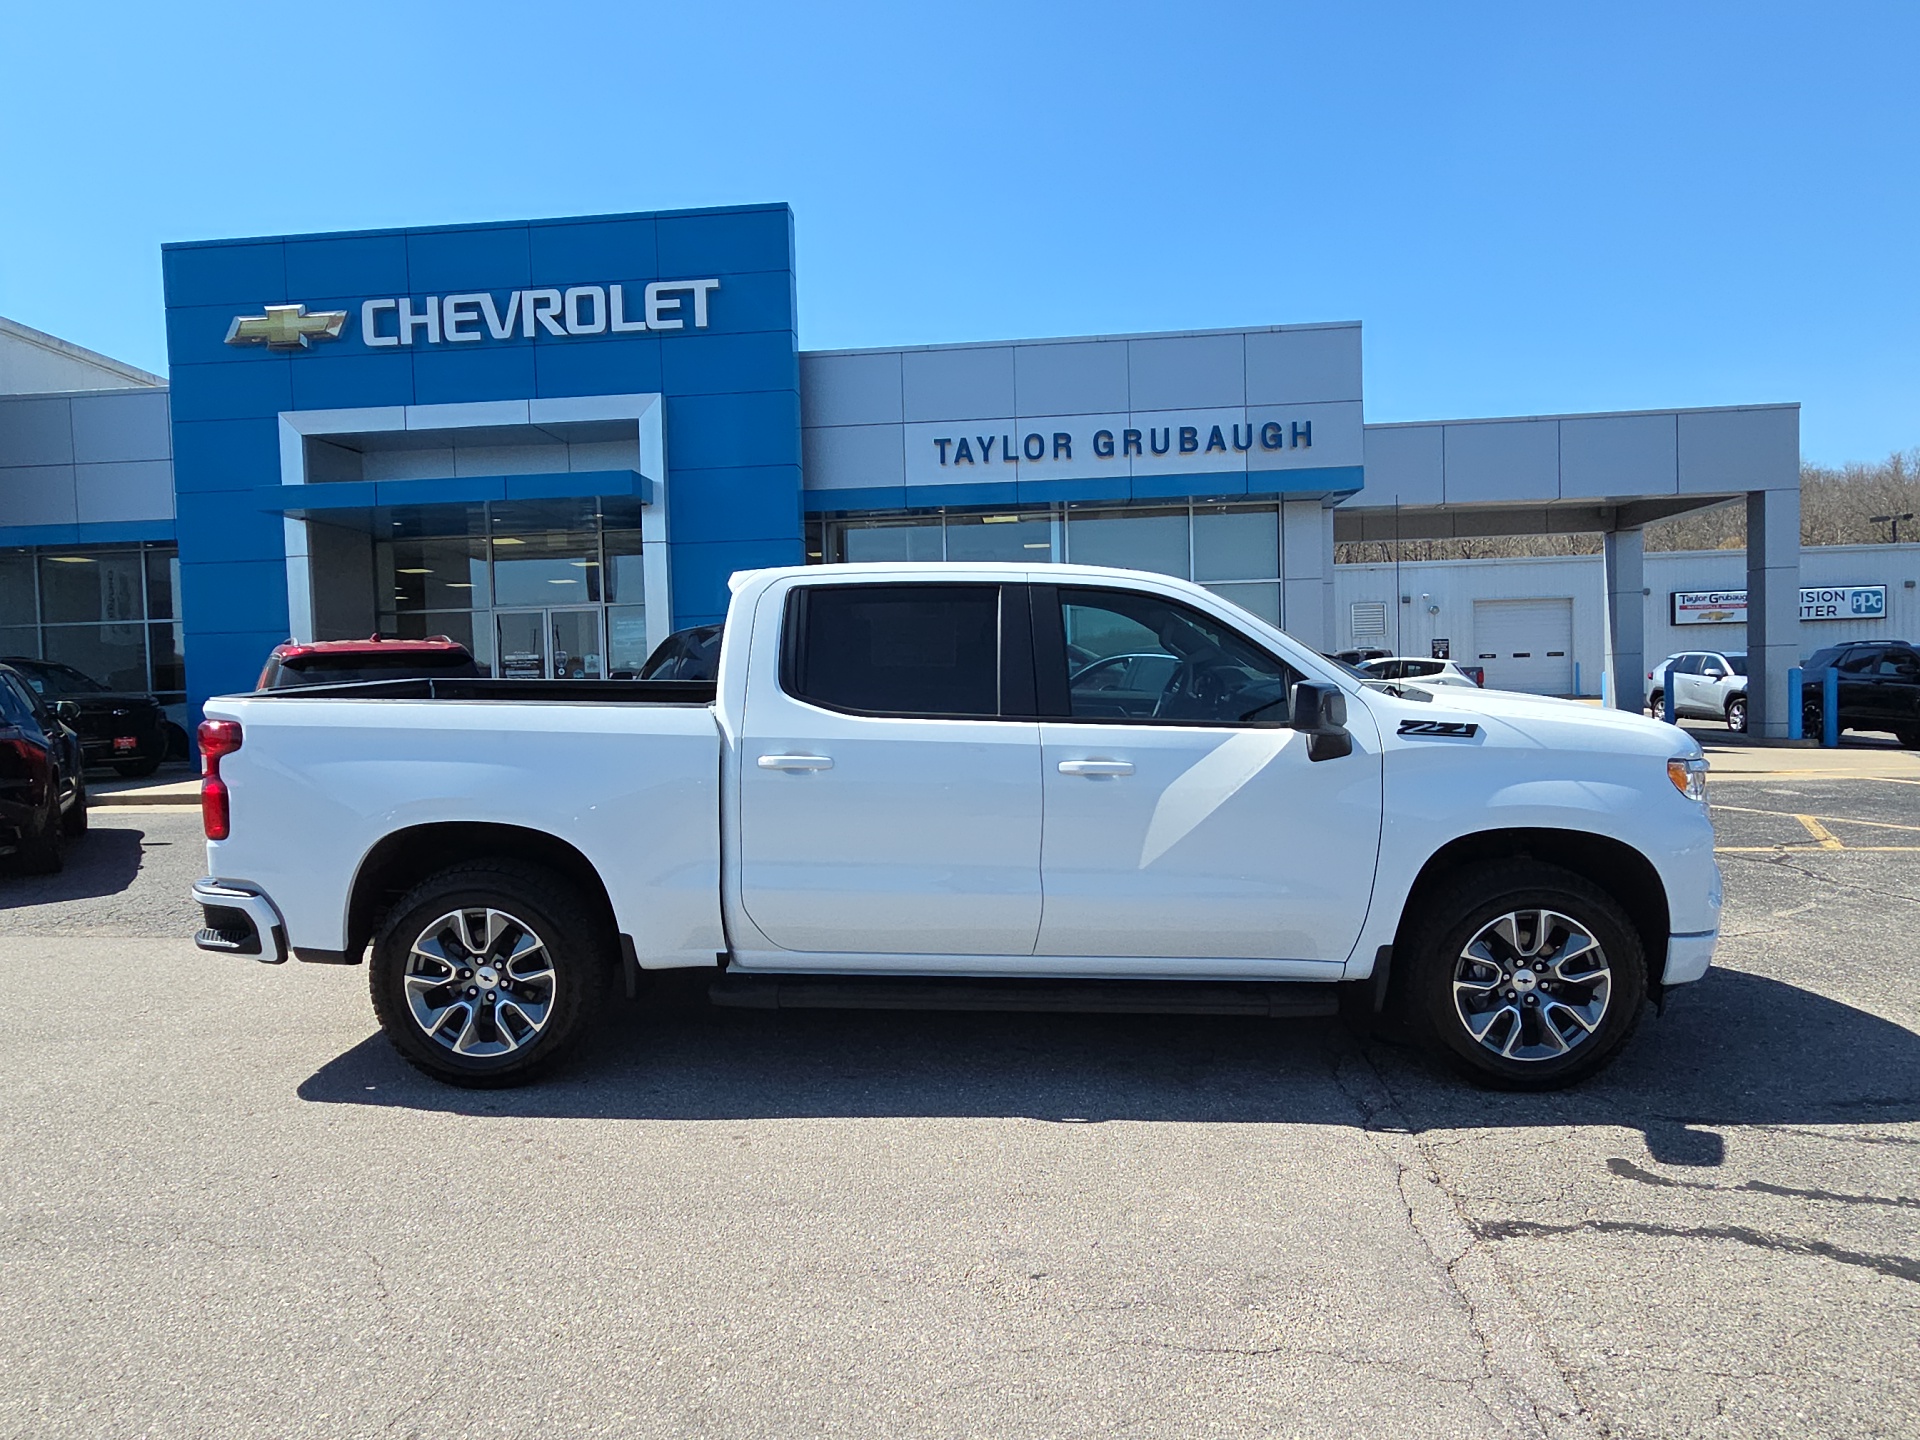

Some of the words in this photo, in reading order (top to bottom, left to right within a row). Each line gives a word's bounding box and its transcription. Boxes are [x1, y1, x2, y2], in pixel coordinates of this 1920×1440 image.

[361, 278, 719, 346] CHEVROLET
[933, 432, 1073, 466] TAYLOR
[1092, 420, 1313, 459] GRUBAUGH
[1679, 594, 1708, 605] Taylor
[1852, 592, 1882, 613] PPG
[1799, 605, 1838, 617] TER
[1396, 719, 1479, 738] Z71
